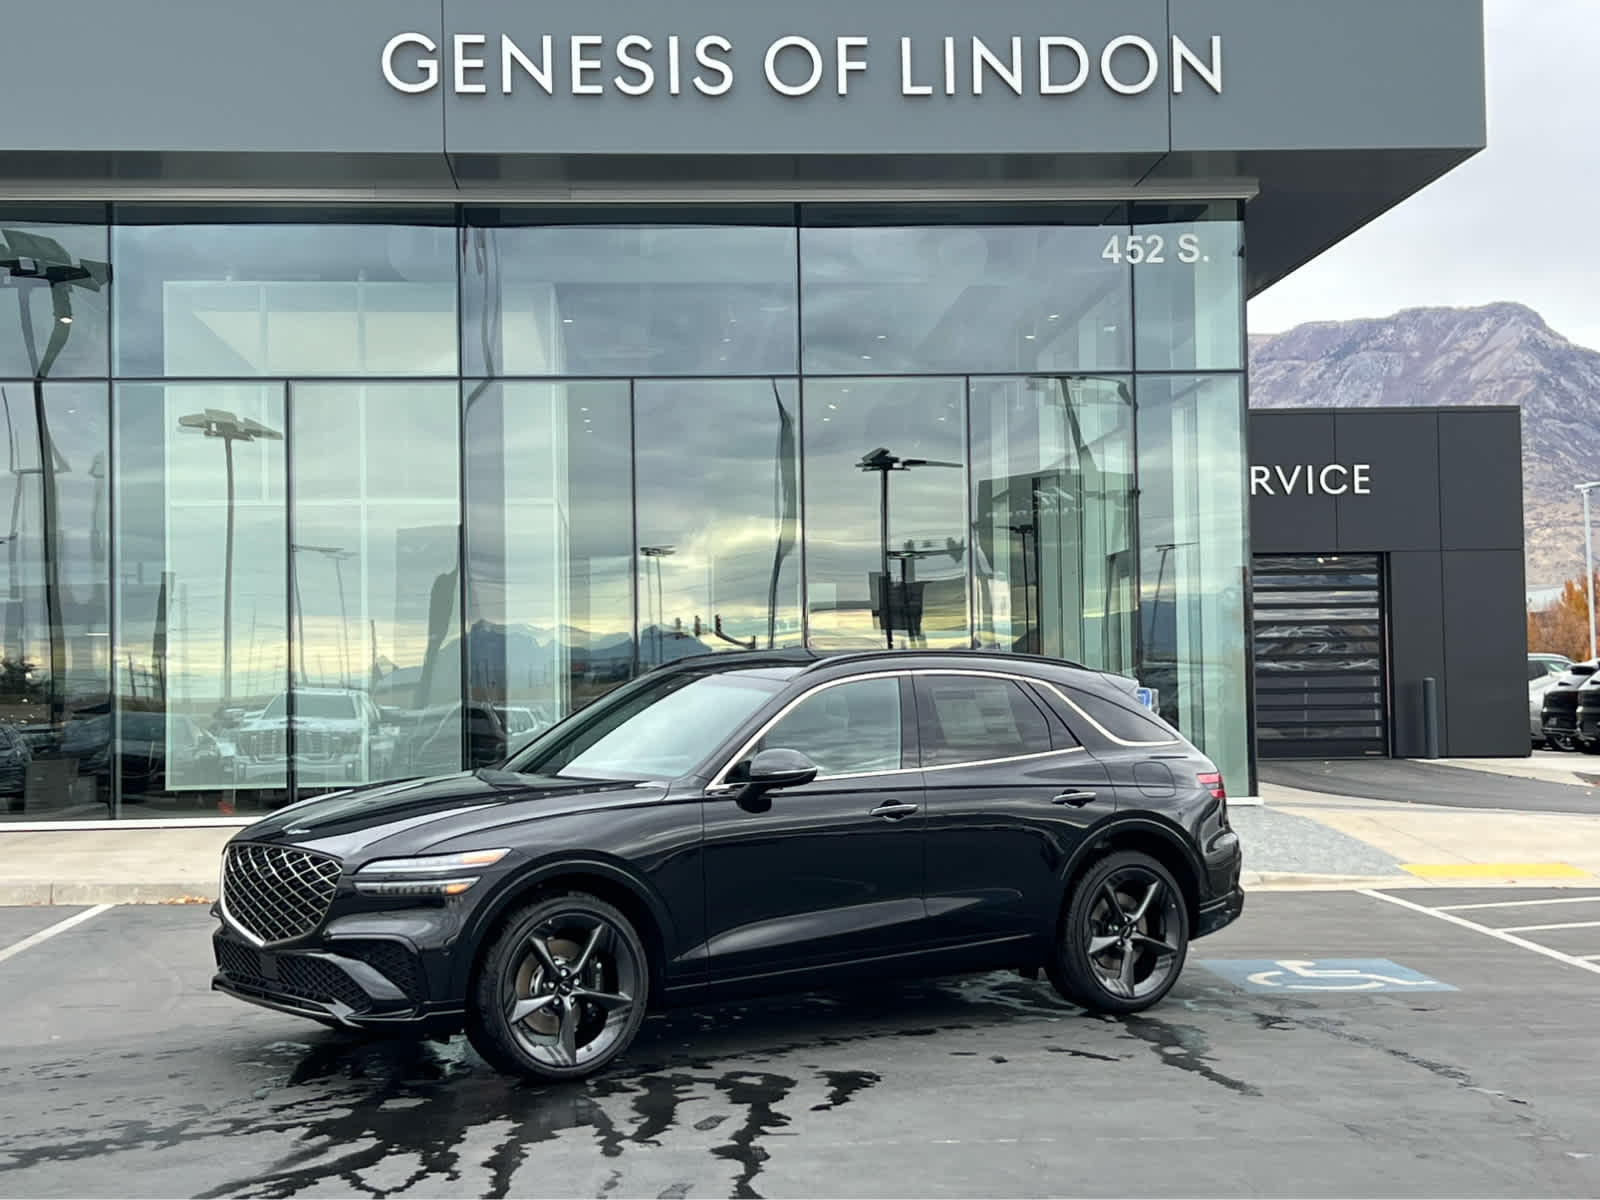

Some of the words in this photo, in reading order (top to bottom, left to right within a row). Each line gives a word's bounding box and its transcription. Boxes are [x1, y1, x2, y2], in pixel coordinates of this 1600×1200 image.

[381, 32, 733, 95] GENESIS
[764, 36, 868, 95] OF
[901, 35, 1222, 95] LINDON
[1102, 234, 1164, 264] 452
[1177, 233, 1209, 263] S.
